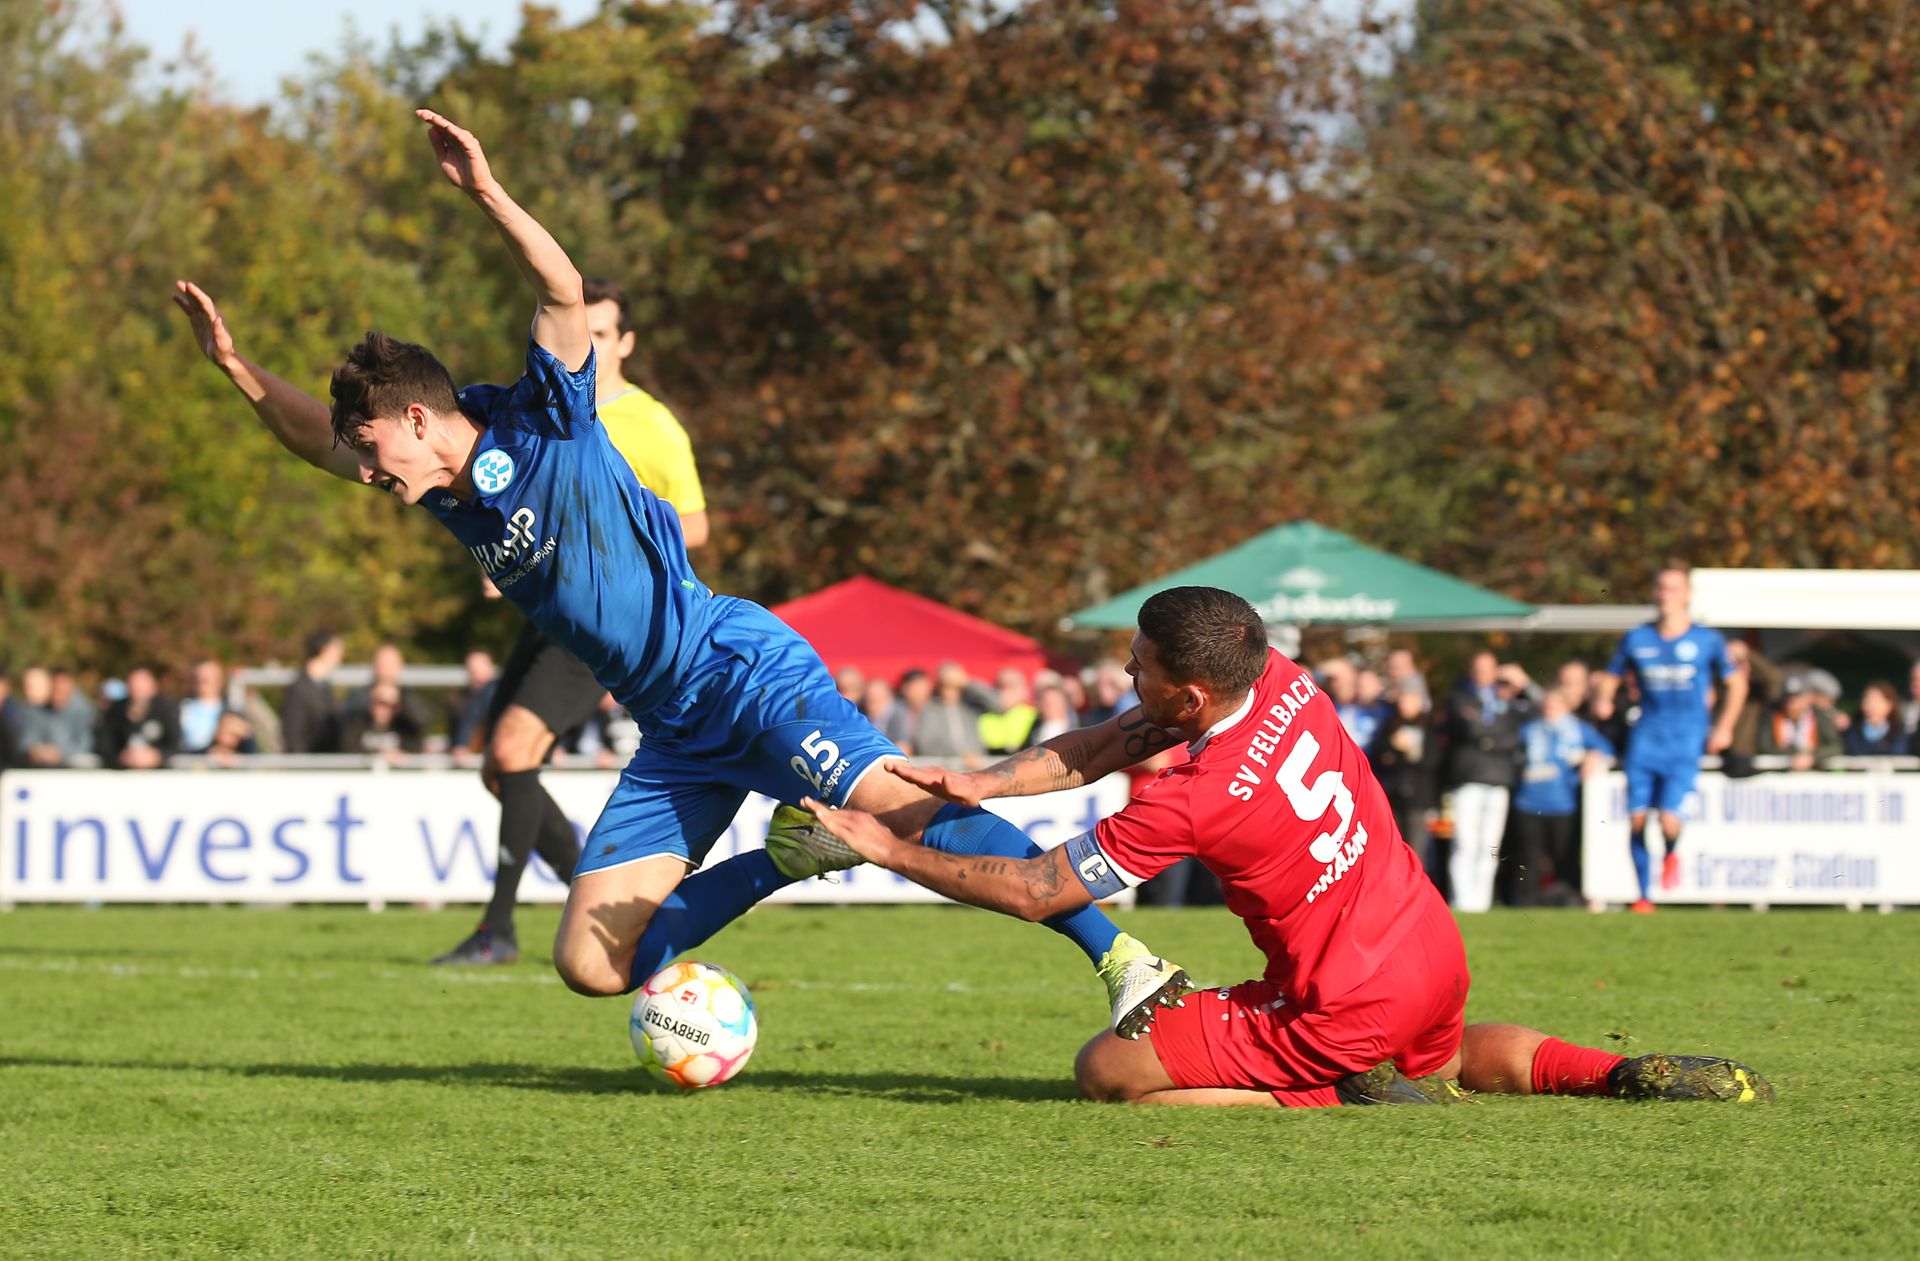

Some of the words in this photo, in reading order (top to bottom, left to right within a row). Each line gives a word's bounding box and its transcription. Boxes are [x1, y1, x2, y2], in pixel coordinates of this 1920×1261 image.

[522, 536, 557, 572] COMPANY
[790, 729, 841, 792] 25
[1227, 763, 1262, 803] SV
[1247, 672, 1318, 769] FELLBACH
[15, 786, 365, 884] invest
[1275, 729, 1356, 864] 5
[644, 1007, 710, 1047] DERBYSTAR
